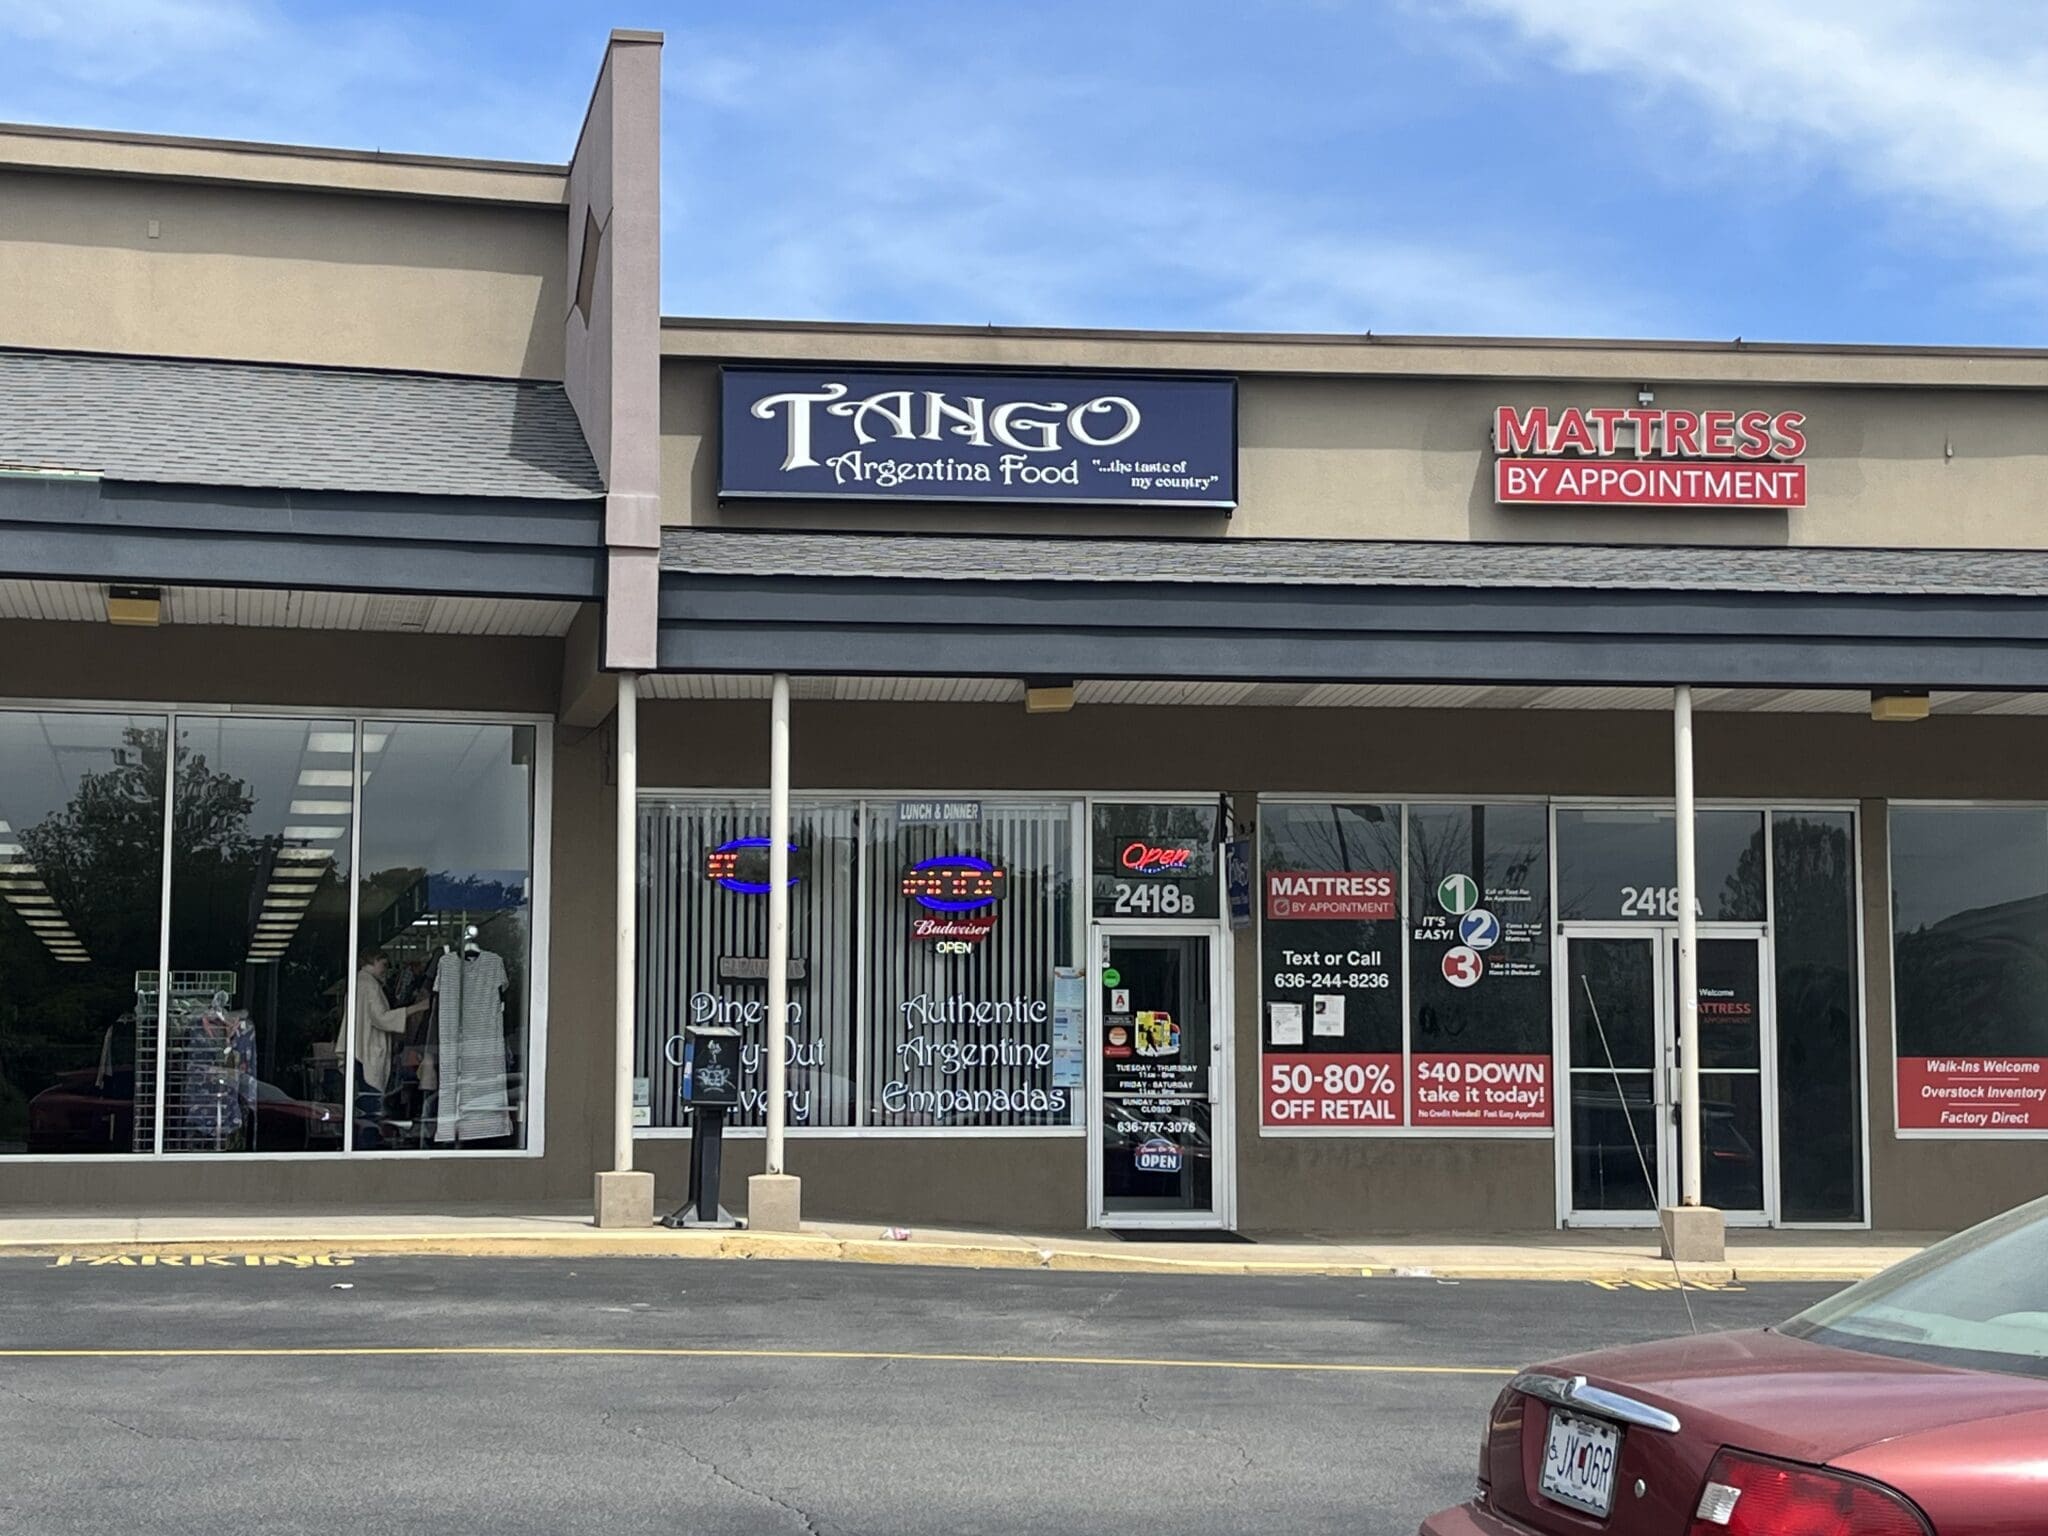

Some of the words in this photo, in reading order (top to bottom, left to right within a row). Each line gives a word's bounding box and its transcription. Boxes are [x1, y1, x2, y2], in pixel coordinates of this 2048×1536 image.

[750, 383, 1141, 473] TANGO
[1494, 406, 1807, 460] MATTRESS
[826, 450, 991, 486] Argentina
[1000, 454, 1079, 485] Food
[1135, 461, 1171, 473] taste
[1172, 460, 1187, 473] of
[1131, 477, 1152, 490] my
[1508, 467, 1547, 495] BY
[1555, 468, 1799, 499] APPOINTMENT
[900, 803, 932, 820] LUNCH
[934, 803, 941, 819] &
[943, 803, 979, 819] DINNER
[1122, 843, 1190, 868] Open
[1271, 877, 1391, 897] MATTRESS
[1292, 902, 1306, 912] BY
[1308, 902, 1389, 913] APPOINTMENT
[913, 919, 991, 936] Budweiser
[1422, 916, 1446, 927] IT'S
[1414, 929, 1454, 940] EASY!
[936, 941, 972, 954] OPEN
[1282, 950, 1320, 966] Text
[1324, 954, 1343, 966] or
[1347, 950, 1381, 966] Call
[1274, 973, 1389, 988] 636-244-8236
[1699, 988, 1734, 997] Welcome
[690, 992, 802, 1026] Dine-n
[900, 994, 1047, 1029] Authentic
[897, 1036, 1052, 1073] Argentine
[1418, 1061, 1461, 1083] $40
[1465, 1062, 1545, 1084] DOWN
[1926, 1060, 1980, 1073] Walk-Ins
[1983, 1060, 2040, 1073] Welcome
[1271, 1063, 1396, 1095] 50-80%
[881, 1080, 1066, 1122] Empanadas
[1418, 1085, 1460, 1103] take
[1465, 1086, 1480, 1103] it
[1485, 1085, 1545, 1108] today!
[1921, 1085, 1985, 1098] Overstock
[1987, 1085, 2047, 1101] Inventory
[1271, 1099, 1315, 1120] OFF
[1321, 1099, 1396, 1120] RETAIL
[1940, 1111, 1988, 1126] Factory
[1991, 1111, 2029, 1124] Direct
[1141, 1154, 1177, 1169] OPEN
